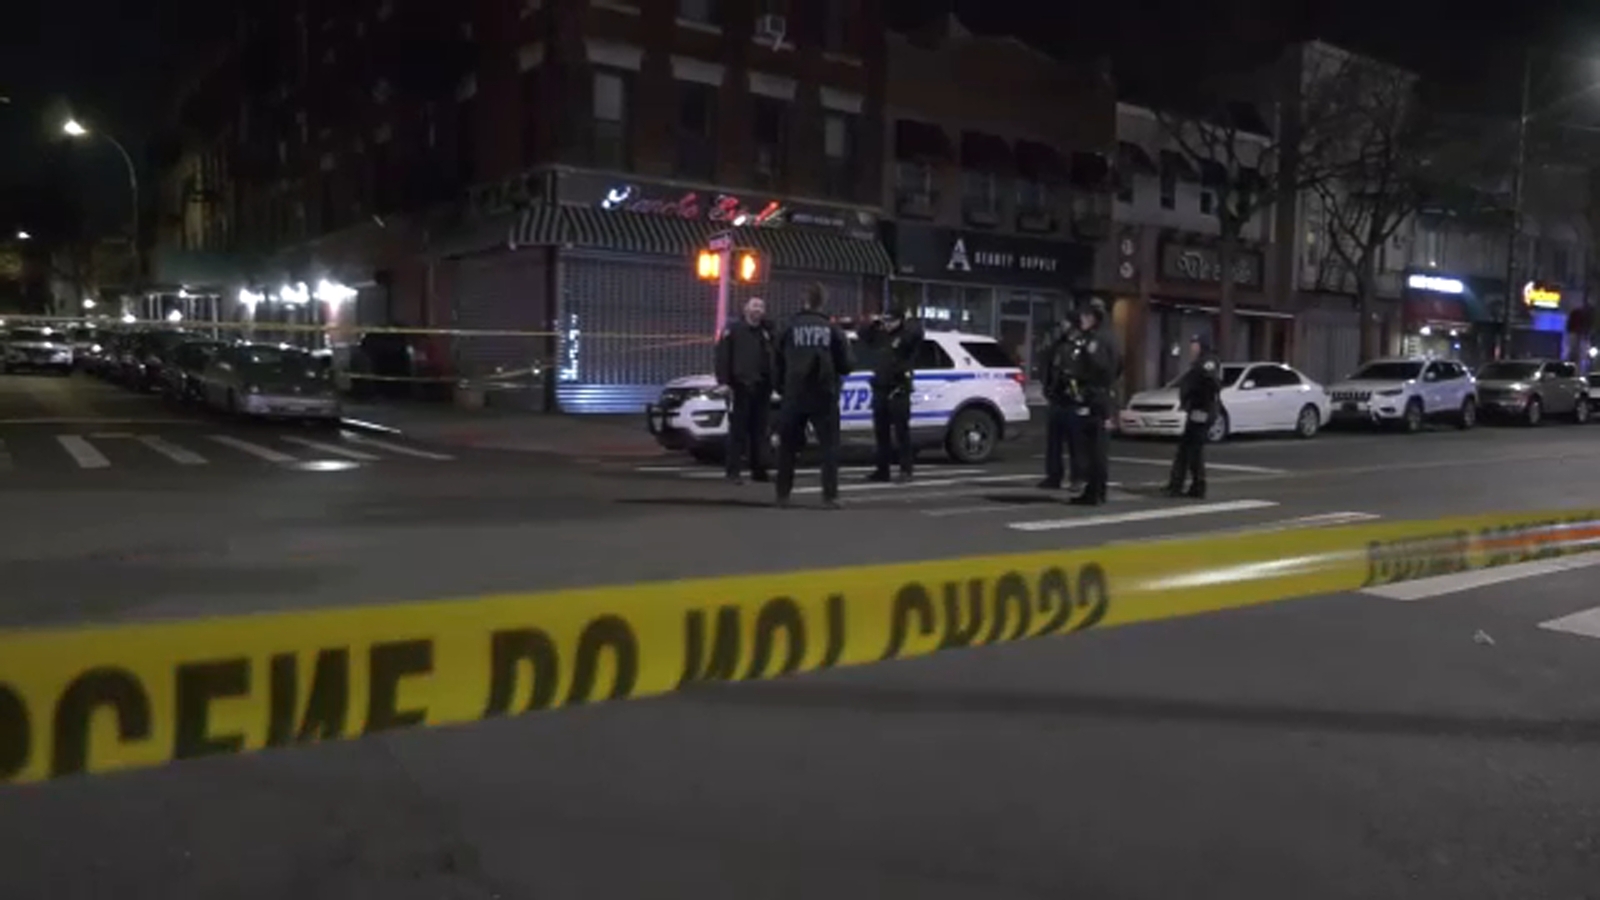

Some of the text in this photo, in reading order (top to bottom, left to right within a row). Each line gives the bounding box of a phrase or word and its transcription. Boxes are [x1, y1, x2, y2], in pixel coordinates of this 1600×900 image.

[946, 238, 1057, 272] A BEAUTY SUPPLY
[793, 326, 831, 347] NYPD
